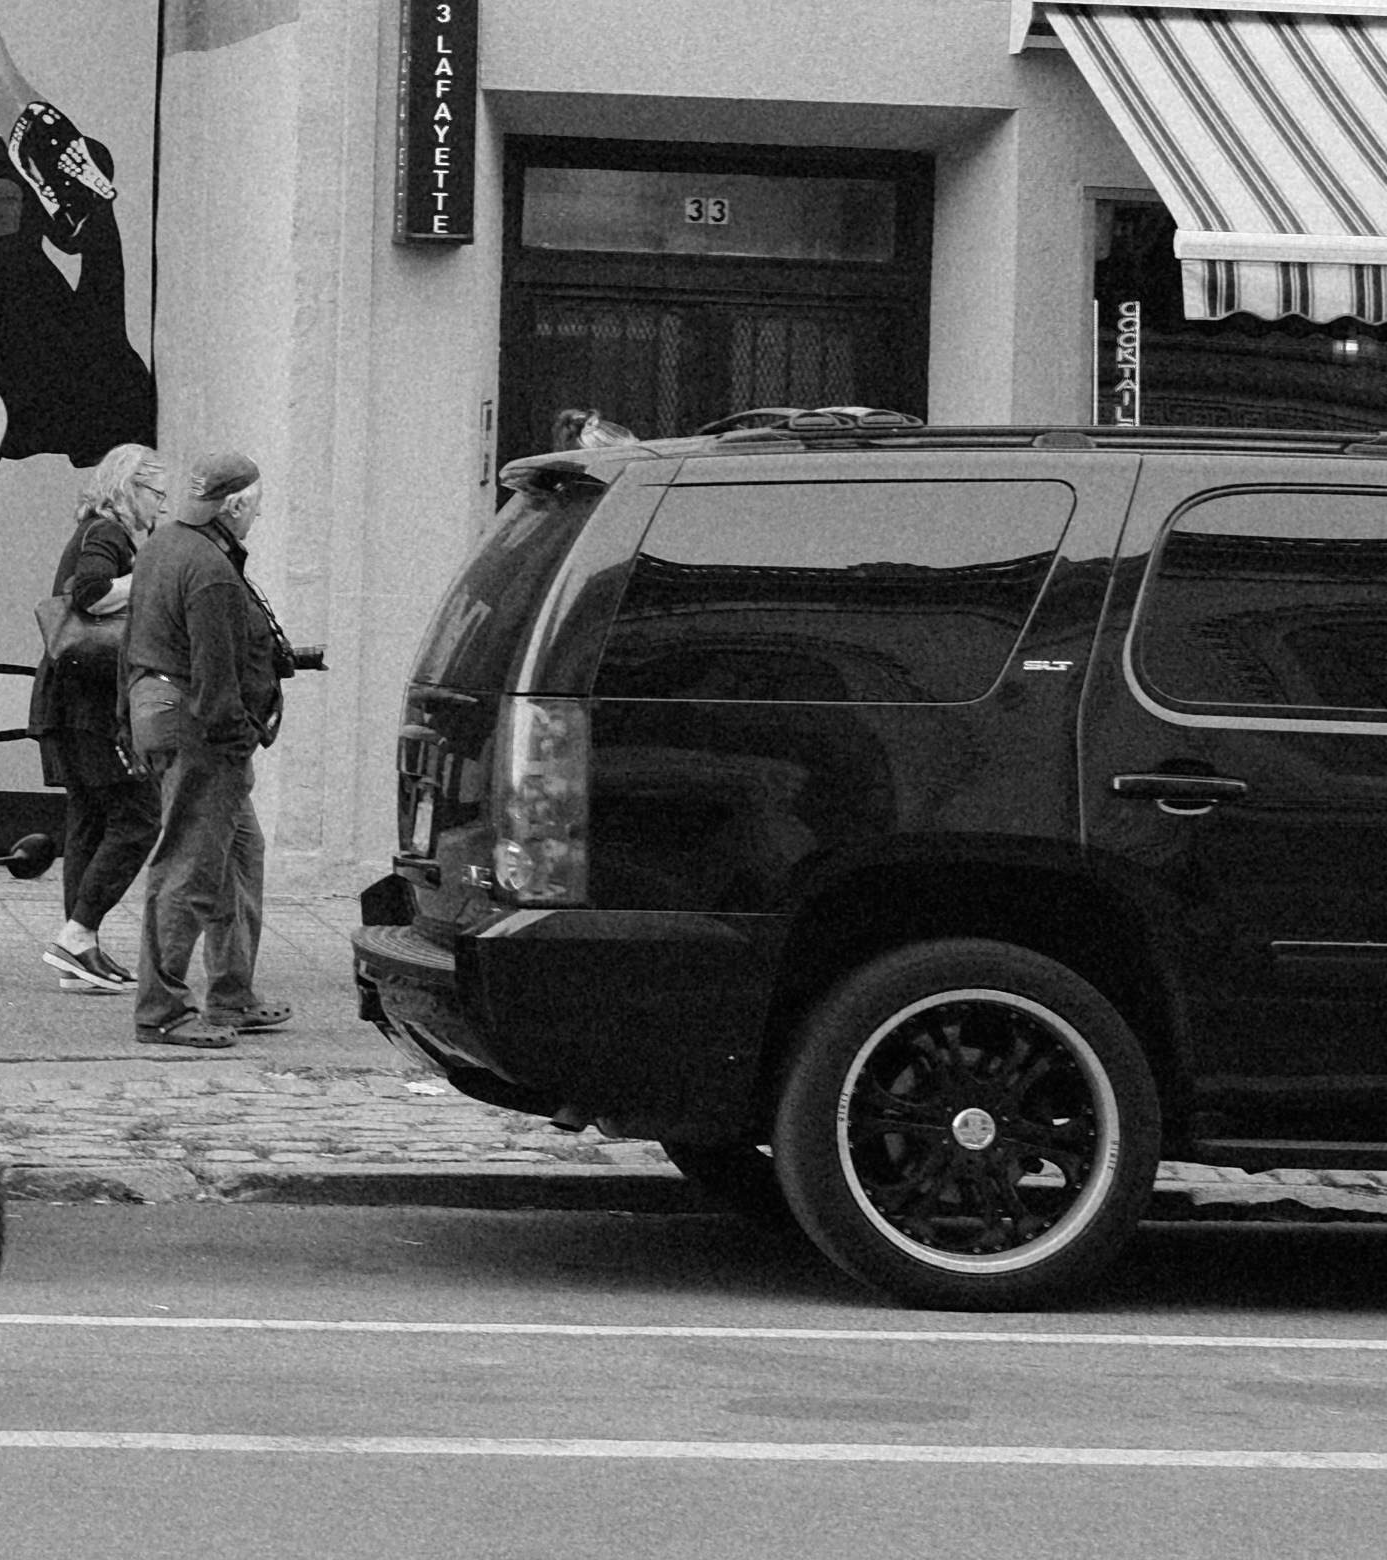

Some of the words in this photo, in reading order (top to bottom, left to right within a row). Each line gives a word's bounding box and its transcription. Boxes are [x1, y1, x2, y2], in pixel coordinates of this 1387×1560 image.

[431, 34, 455, 235] LAFAYETTE
[687, 198, 726, 223] 33
[1114, 300, 1141, 427] COCKTAIL
